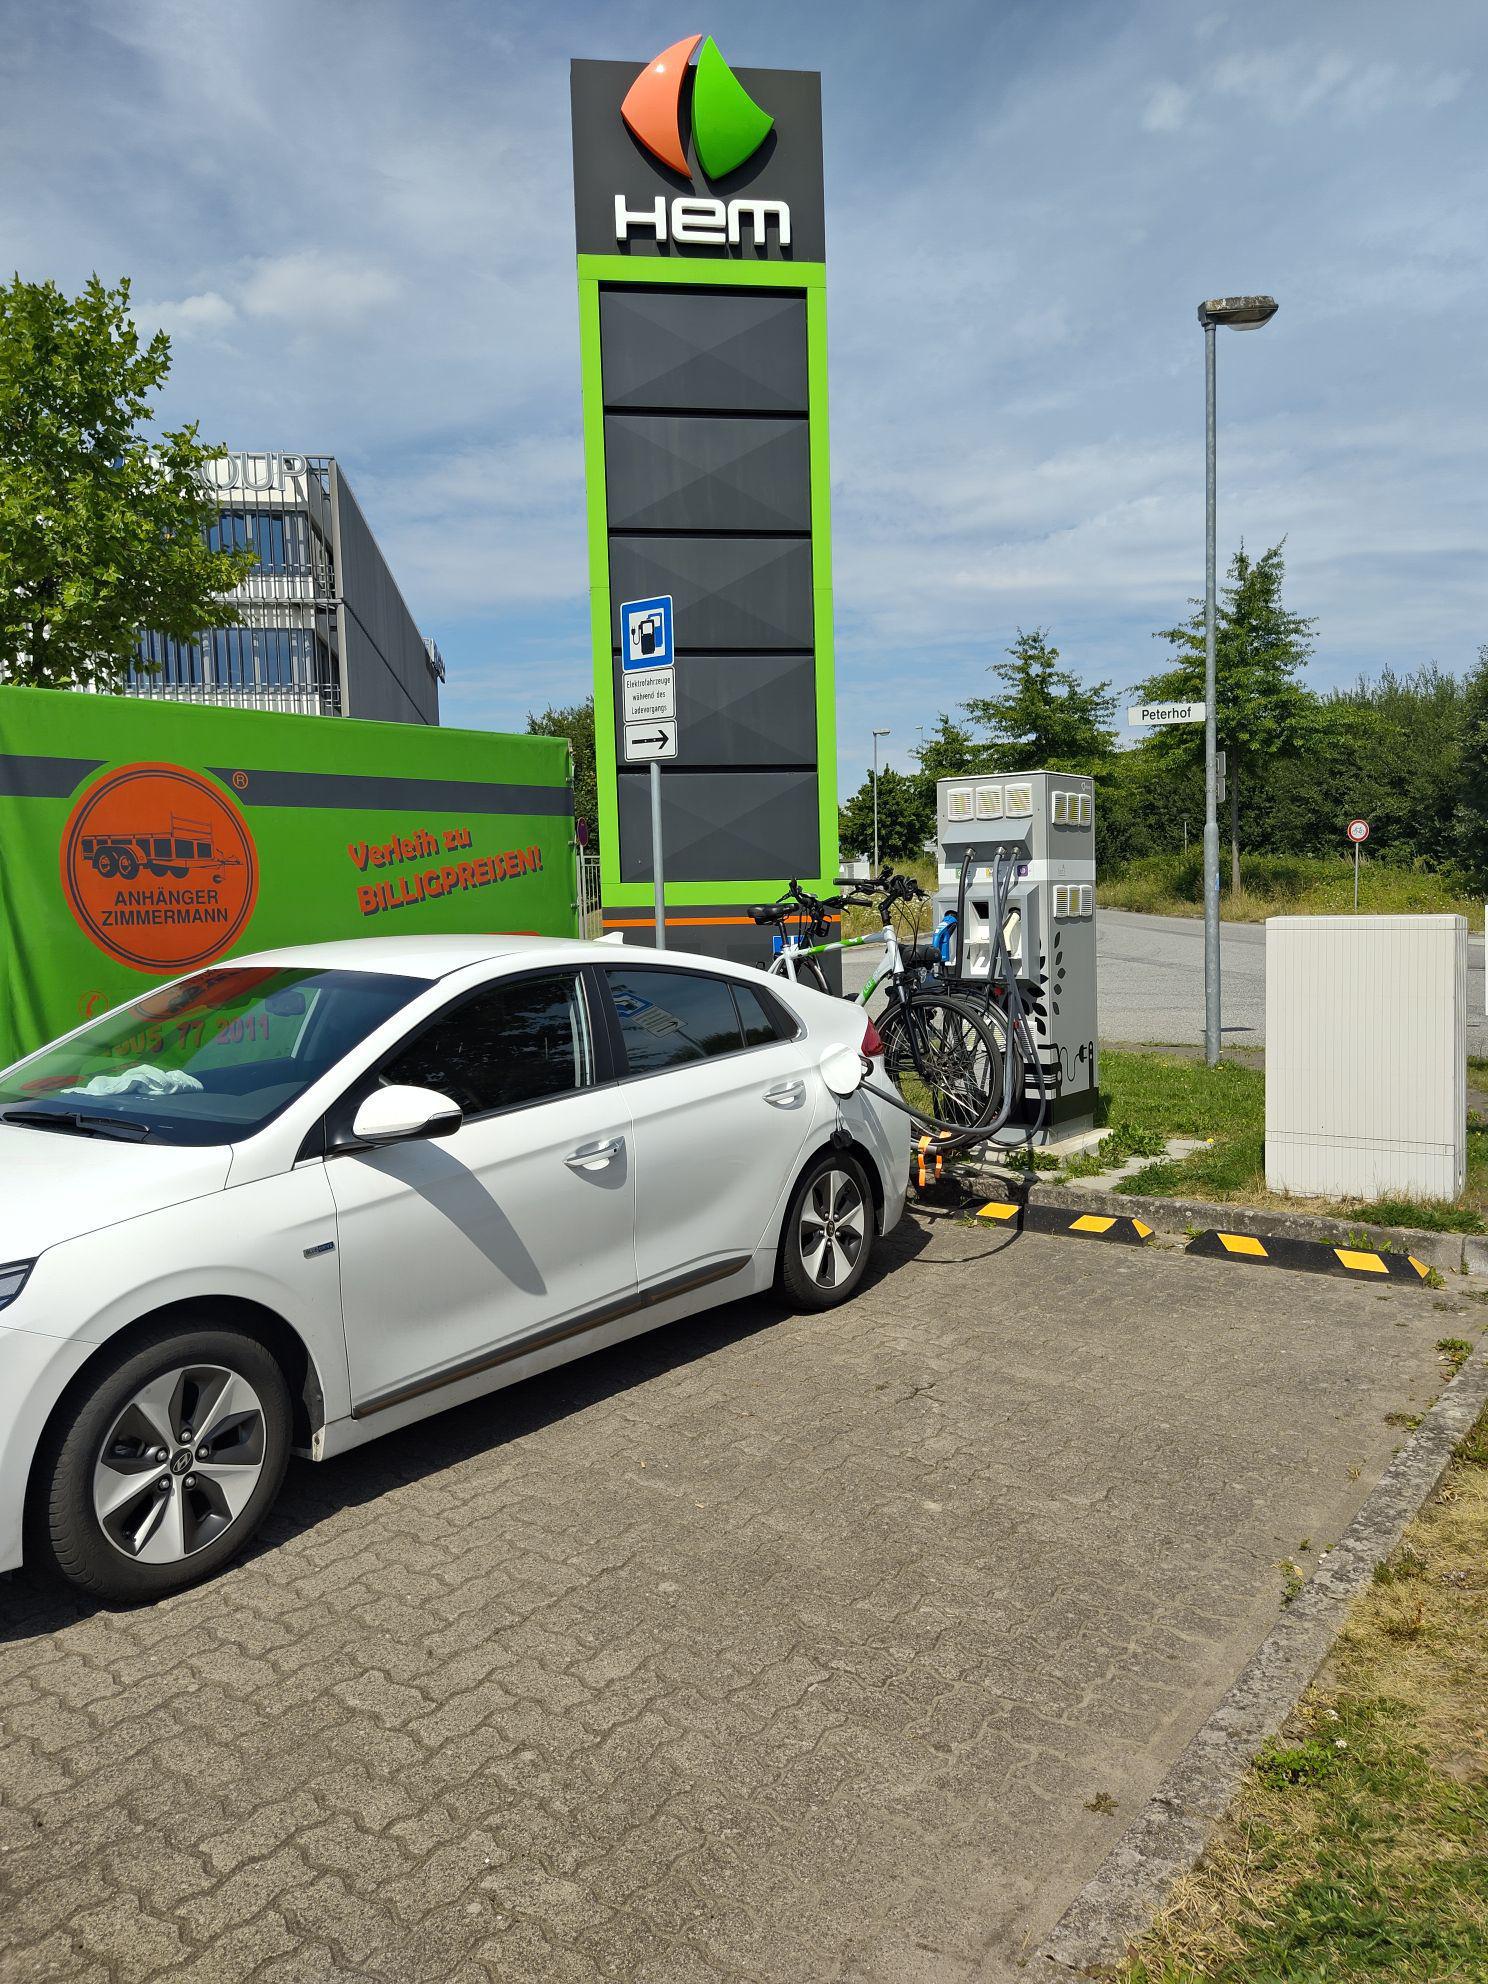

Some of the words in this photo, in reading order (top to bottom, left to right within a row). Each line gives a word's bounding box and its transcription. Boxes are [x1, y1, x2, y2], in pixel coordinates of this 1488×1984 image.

[627, 677, 670, 688] Elektrofahrzeuge
[632, 691, 654, 700] während
[656, 690, 666, 698] des
[632, 704, 667, 714] Ladevorgangs
[1141, 706, 1192, 721] Peterhof
[346, 828, 440, 872] Verleih
[442, 828, 473, 853] zu
[356, 845, 544, 917] BILLIGPREISEN!
[114, 886, 219, 907] ANHÄNGER
[101, 907, 229, 927] ZIMMERMANN
[175, 1019, 206, 1050] 77
[215, 1013, 270, 1046] 2011
